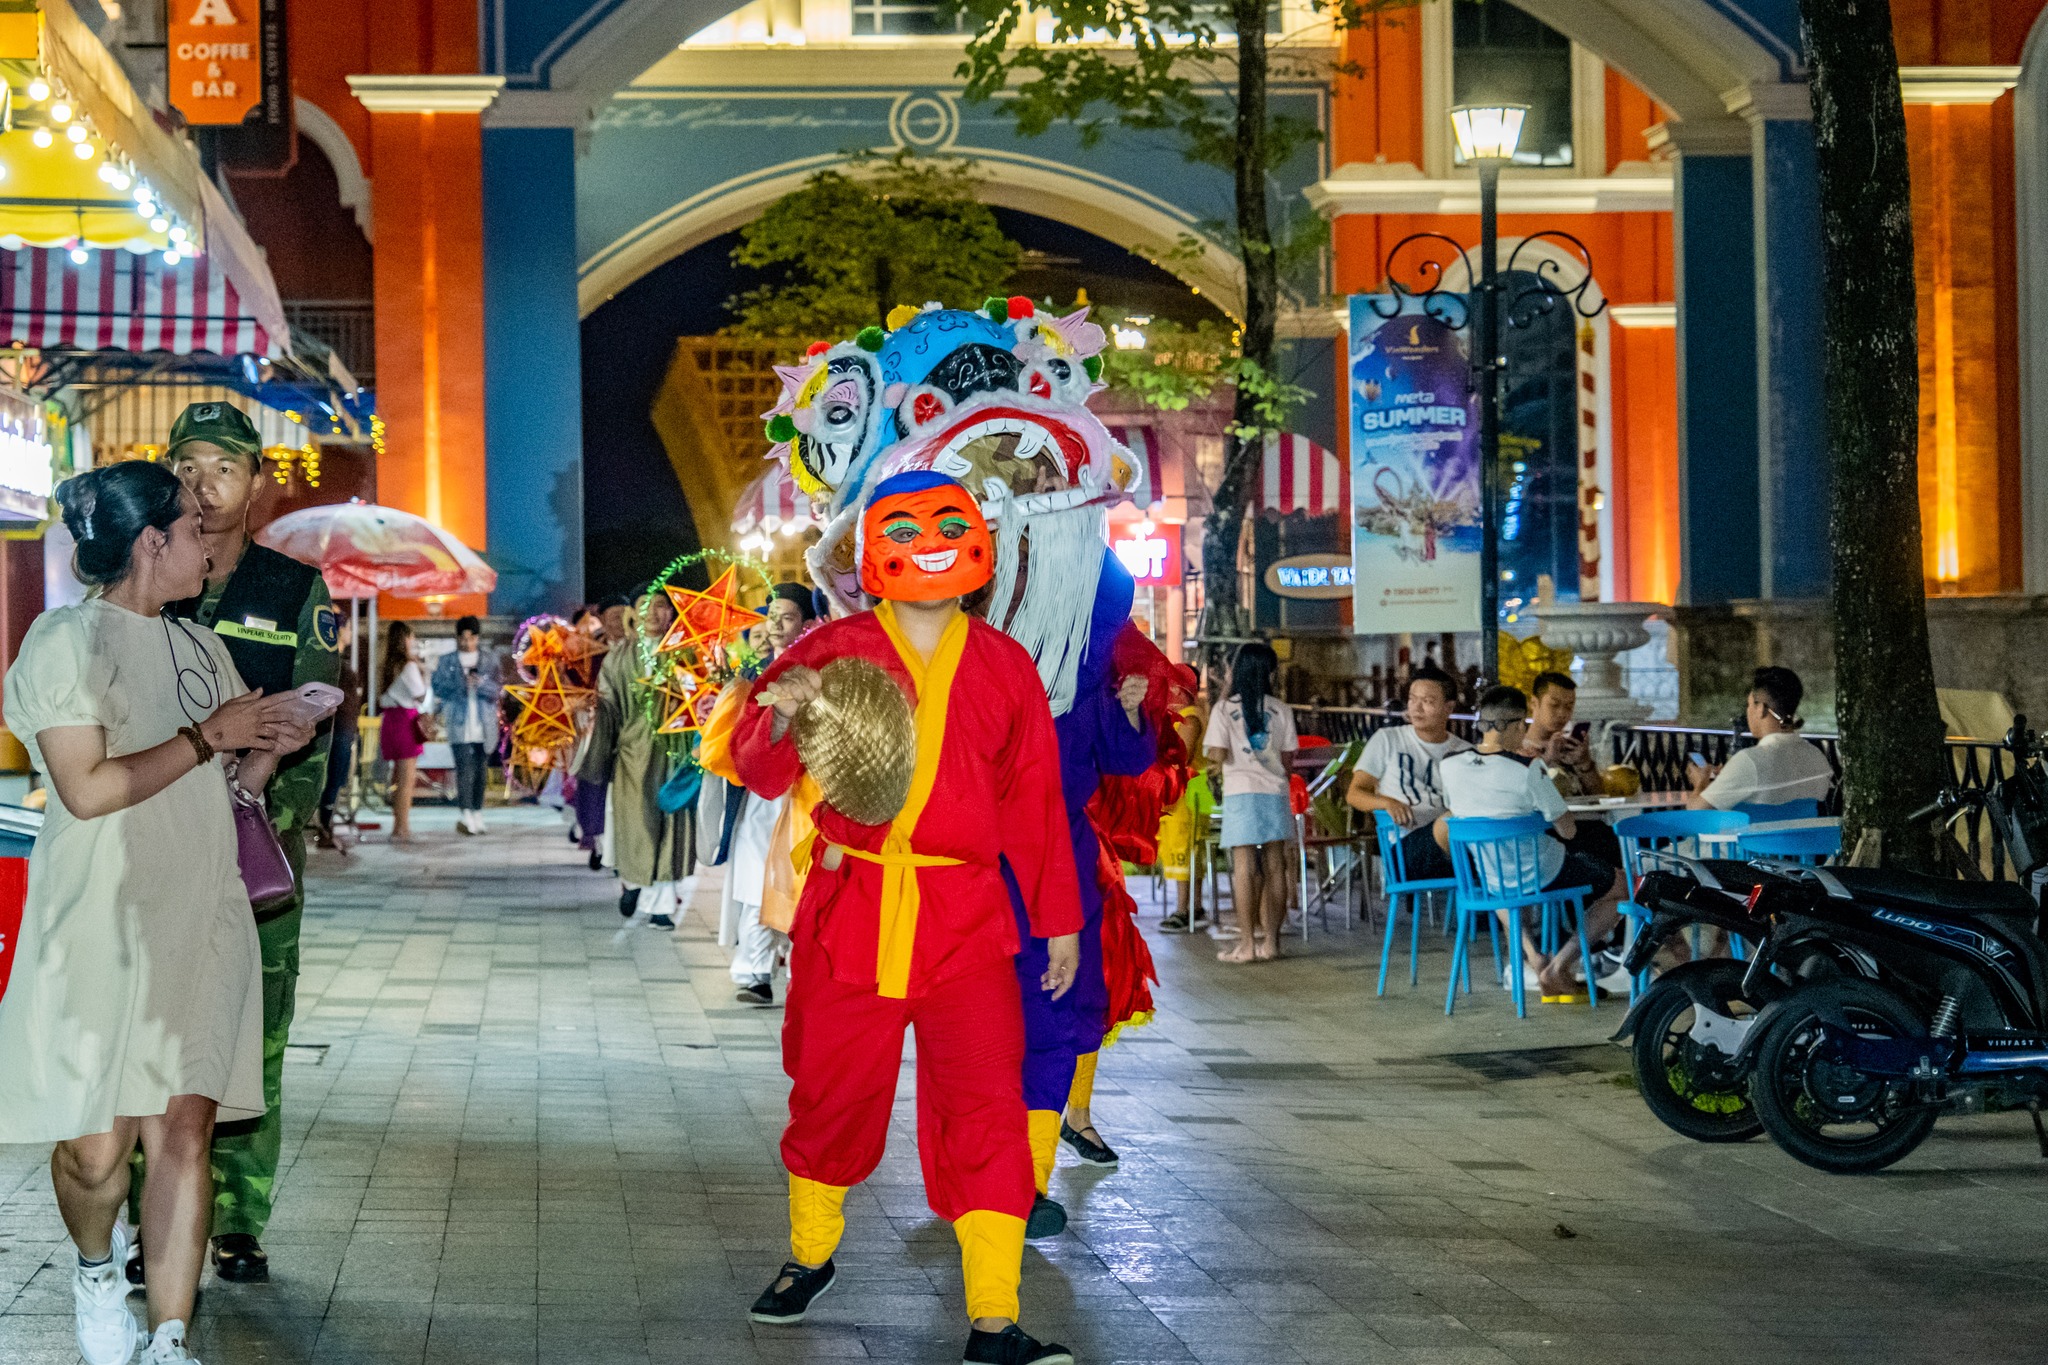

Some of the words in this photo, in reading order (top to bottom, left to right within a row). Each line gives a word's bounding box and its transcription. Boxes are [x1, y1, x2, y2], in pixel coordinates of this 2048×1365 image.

[177, 43, 250, 61] COFFEE
[192, 81, 237, 98] BAR
[1363, 405, 1467, 430] SUMMER
[1987, 1039, 2035, 1047] VINFAST
